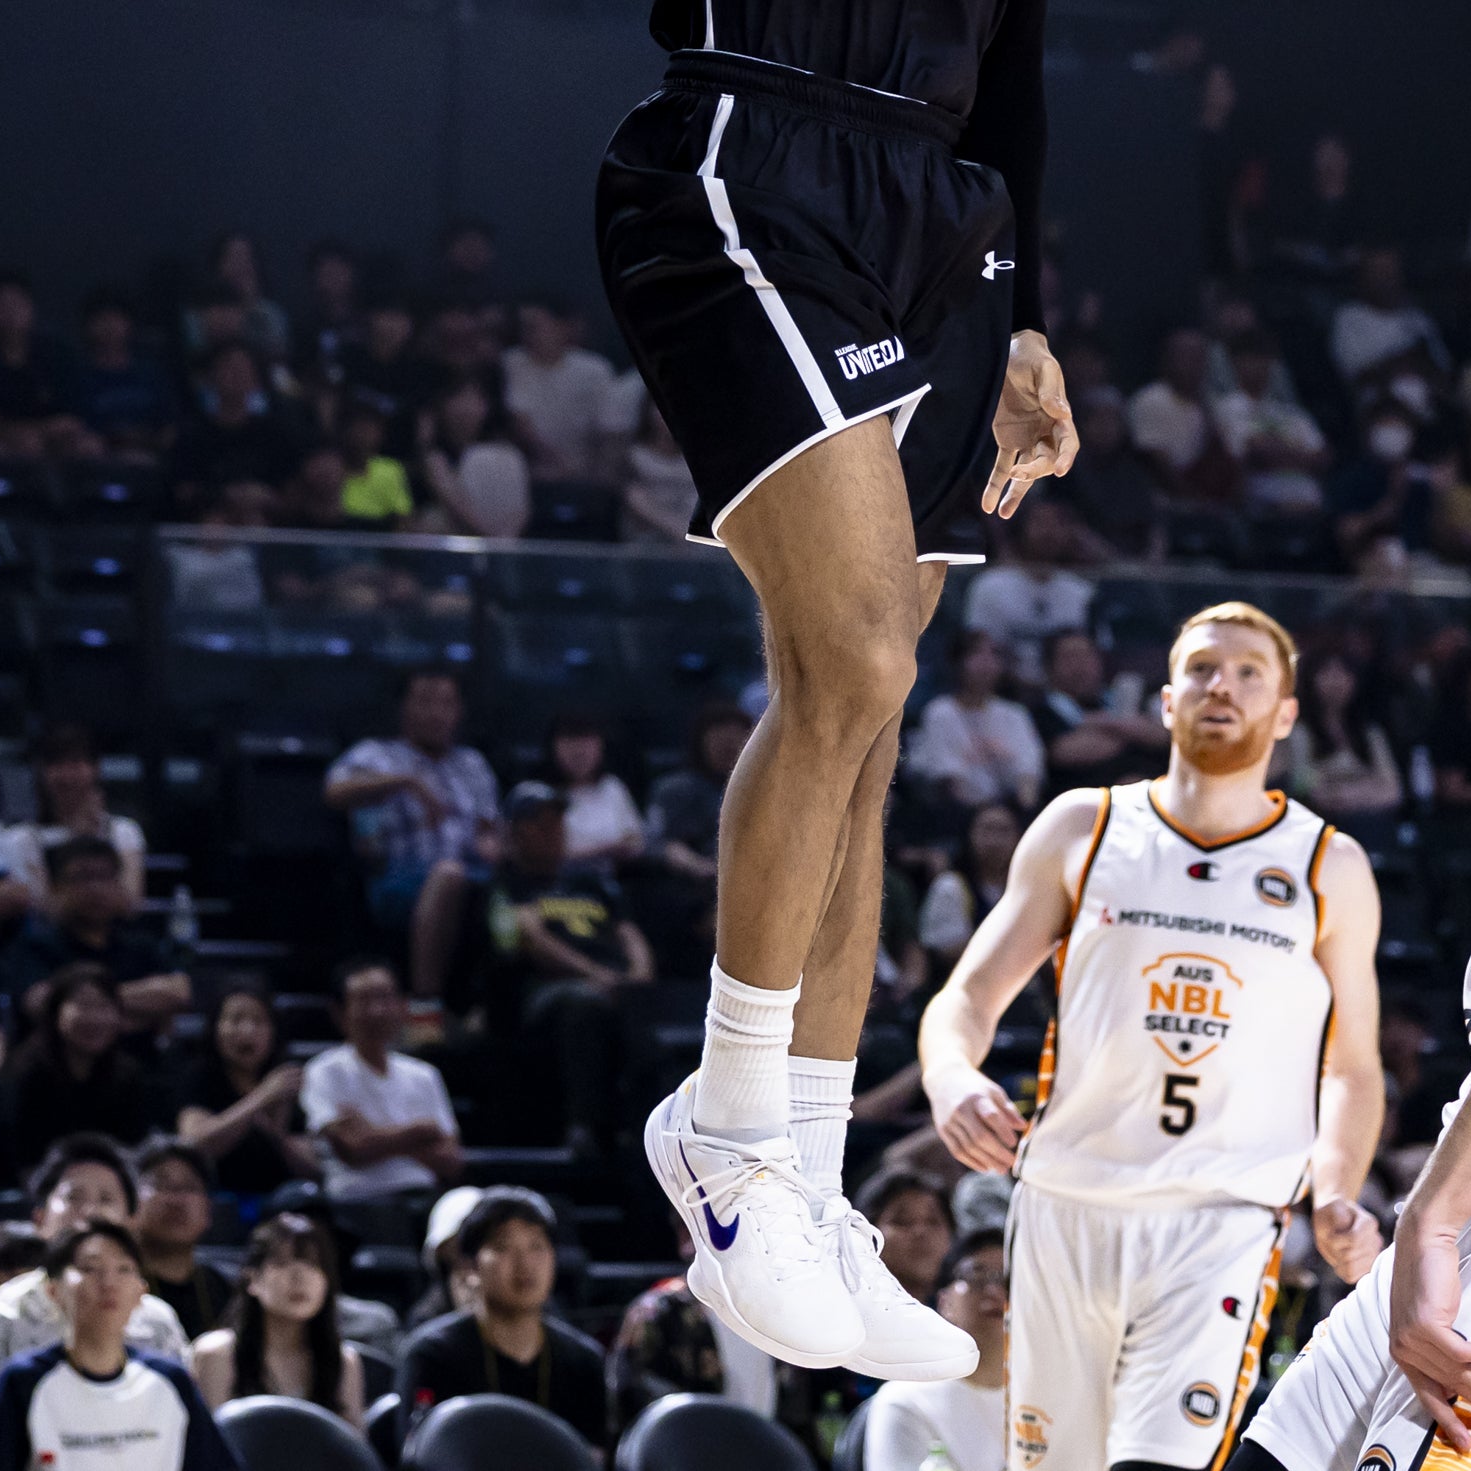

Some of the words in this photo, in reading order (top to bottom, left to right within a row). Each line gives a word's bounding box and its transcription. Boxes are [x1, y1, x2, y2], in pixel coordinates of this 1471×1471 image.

[838, 339, 896, 380] UNITED
[1118, 910, 1227, 935] MITSUBISHI
[1173, 964, 1214, 983] AUS
[1148, 981, 1232, 1019] NBL
[1144, 1014, 1231, 1039] SELECT
[1159, 1072, 1201, 1137] 5
